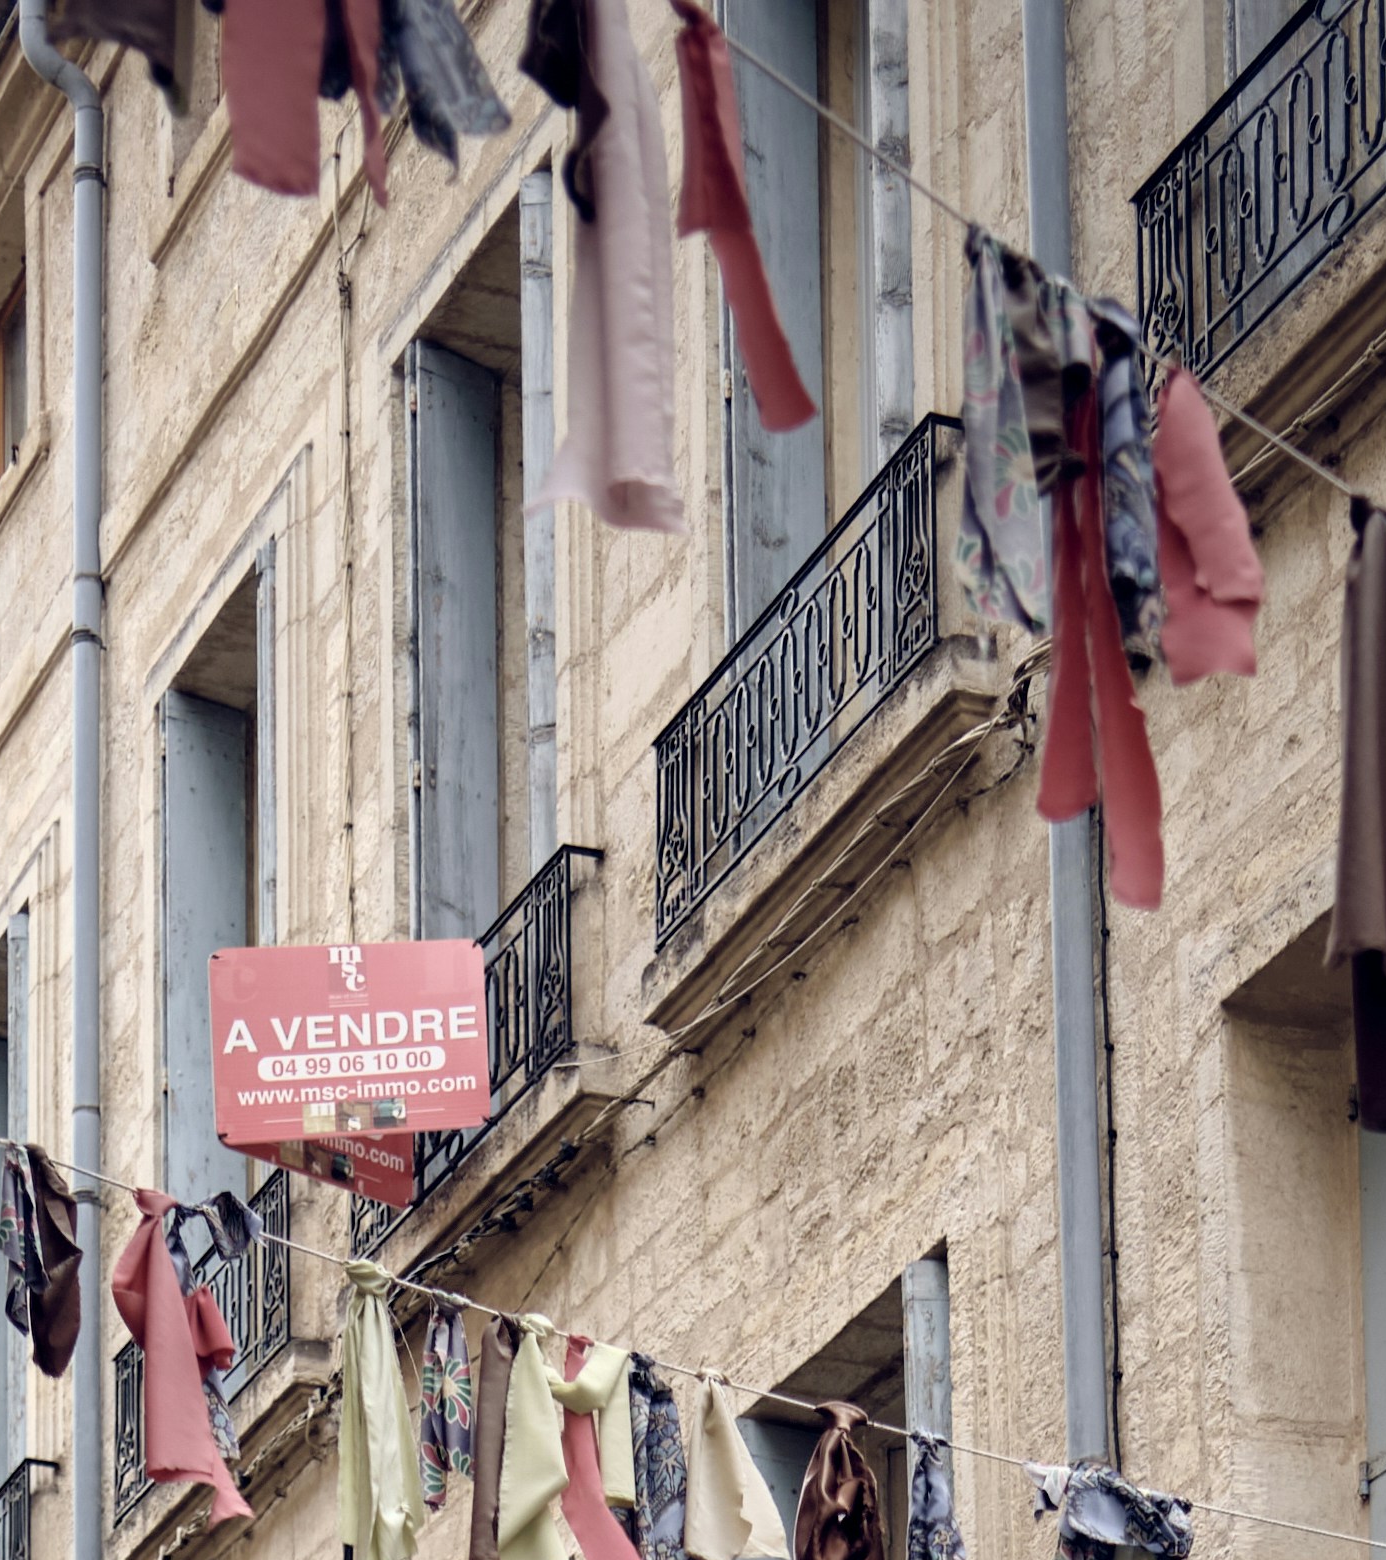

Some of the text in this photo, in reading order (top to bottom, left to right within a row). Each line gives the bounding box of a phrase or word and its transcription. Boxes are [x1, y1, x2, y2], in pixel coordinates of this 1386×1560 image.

[222, 1005, 479, 1055] A VENDRE
[272, 1050, 432, 1077] 04 99 06 10 00
[237, 1073, 476, 1106] www.msc-immo.com
